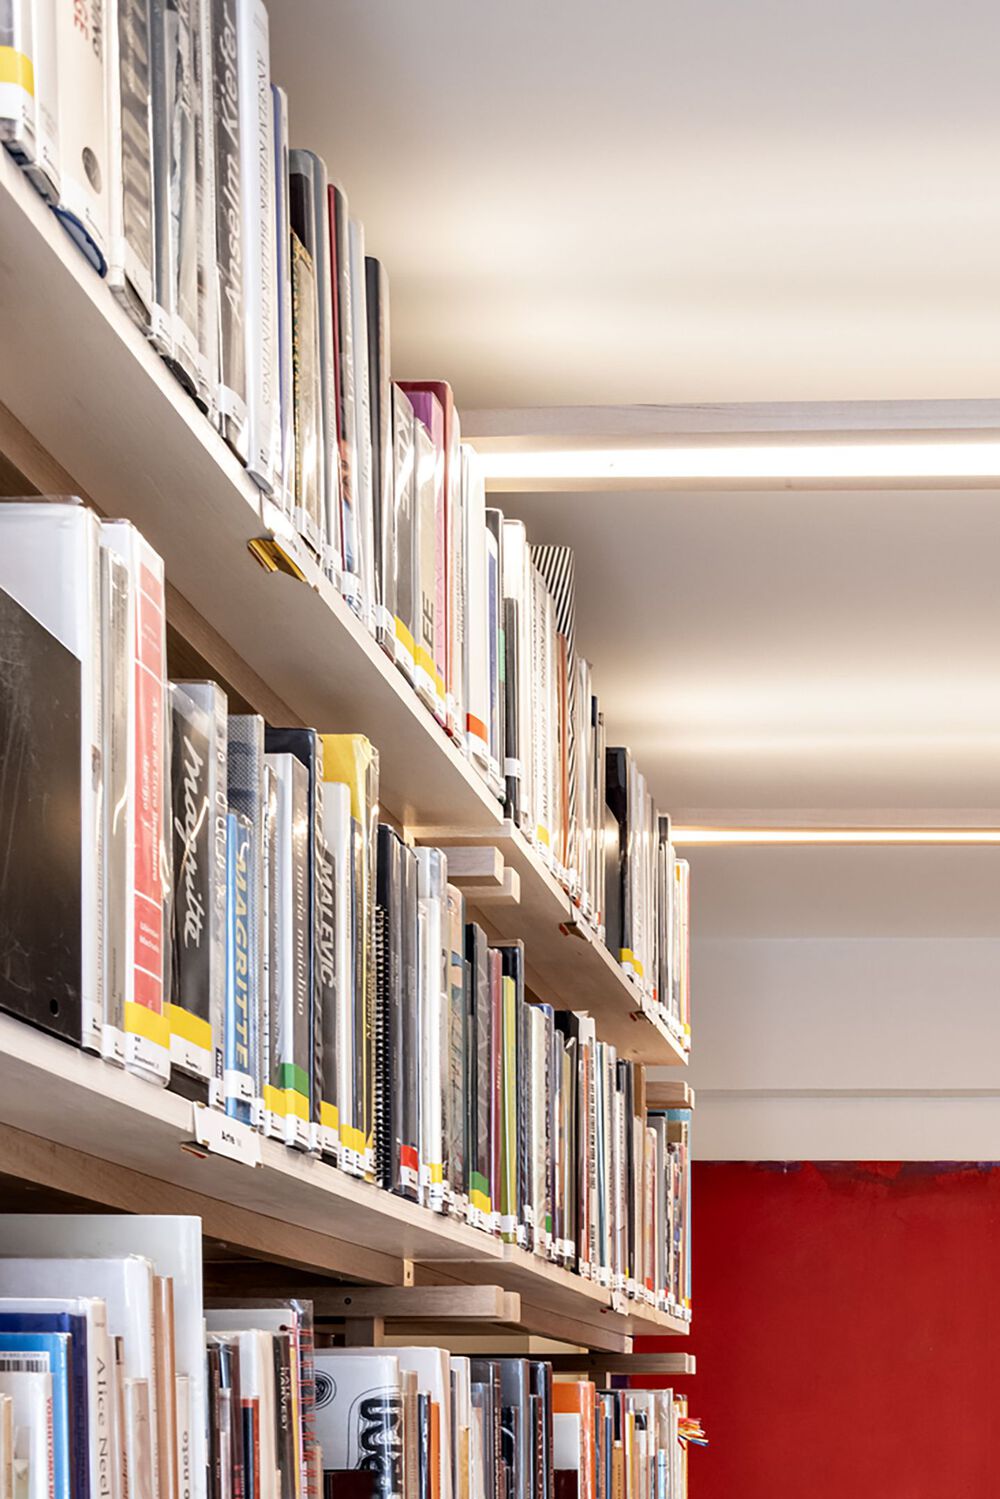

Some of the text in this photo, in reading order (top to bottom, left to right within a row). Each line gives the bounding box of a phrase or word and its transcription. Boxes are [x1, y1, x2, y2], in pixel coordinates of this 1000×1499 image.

[256, 50, 268, 142] ANSELM
[219, 2, 243, 326] Anselm Kiefer
[258, 143, 269, 204] KIEFER
[260, 294, 273, 406] PAINTINGS
[539, 635, 547, 689] KOONS
[174, 736, 206, 948] magritte
[235, 853, 248, 1069] MAGRITTE
[297, 864, 306, 1016] maria maiolino
[318, 857, 335, 989] MALEVIČ
[96, 1357, 110, 1427] Alice
[280, 1367, 289, 1431] HARVEST
[47, 1396, 55, 1484] YOSHITOMO
[98, 1437, 111, 1497] Neel
[183, 1429, 191, 1481] neto
